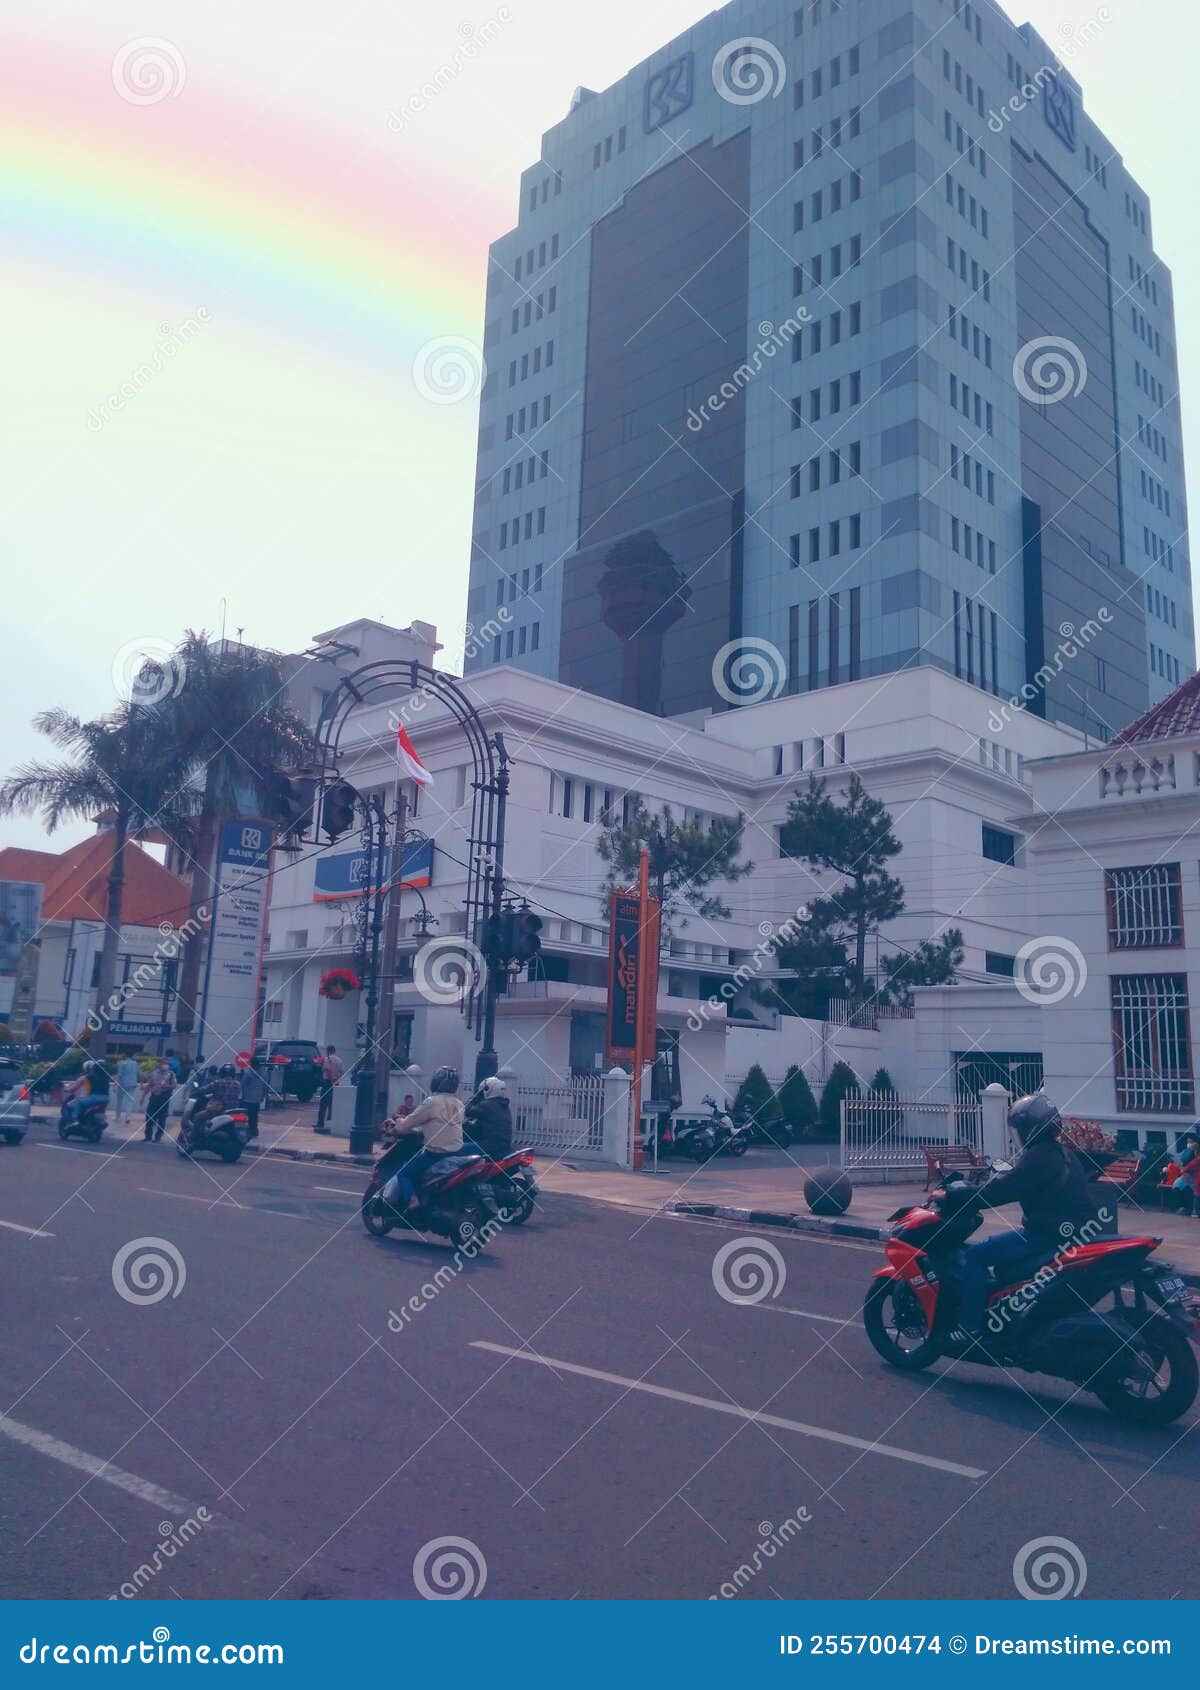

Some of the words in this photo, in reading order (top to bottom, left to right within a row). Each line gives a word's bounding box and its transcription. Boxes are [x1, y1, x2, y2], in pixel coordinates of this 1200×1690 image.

[620, 904, 638, 917] atm
[625, 954, 636, 1025] mandiri
[110, 1023, 162, 1034] PENJAGAAN
